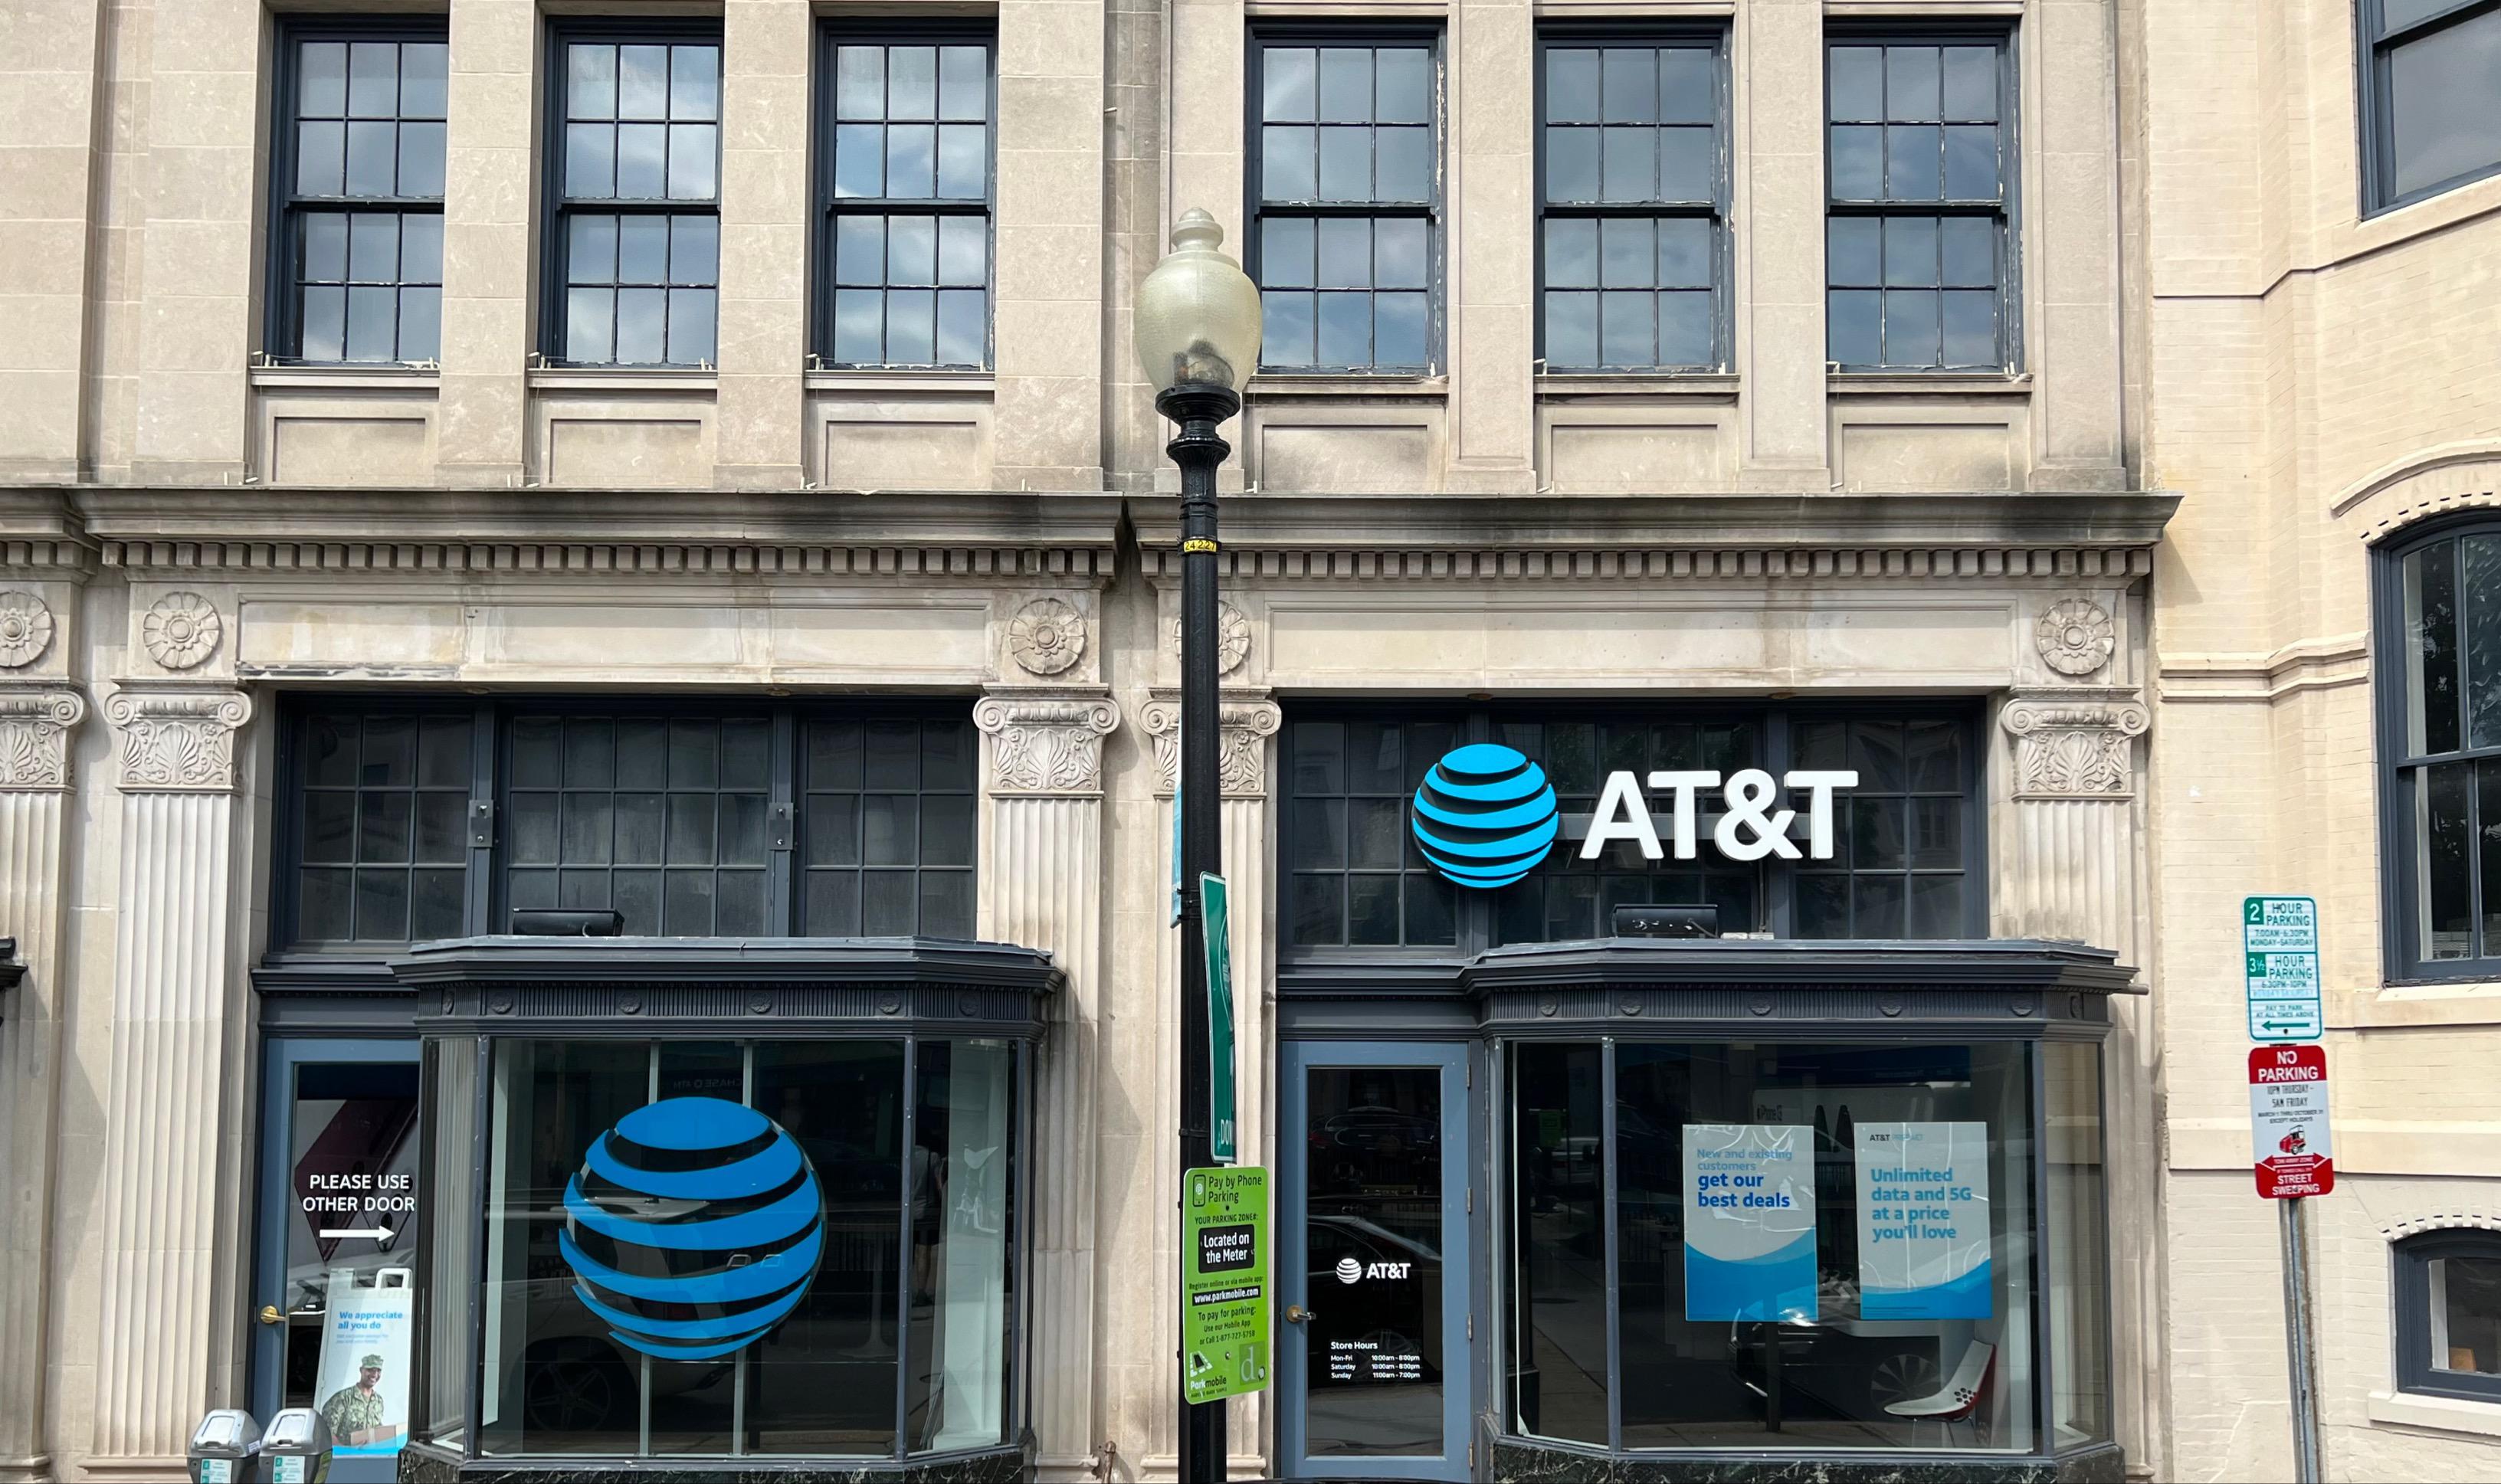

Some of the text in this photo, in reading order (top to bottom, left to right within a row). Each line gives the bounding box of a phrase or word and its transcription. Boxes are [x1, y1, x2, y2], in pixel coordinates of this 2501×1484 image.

[1578, 768, 1859, 862] AT&T
[2250, 903, 2260, 921] 2
[2272, 903, 2303, 913] HOUR
[2267, 916, 2310, 925] PARKING
[2275, 955, 2305, 967] HOUR
[2270, 968, 2313, 979] PARKING
[2276, 1050, 2298, 1064] NO
[2258, 1066, 2319, 1082] PARKING
[1697, 1148, 1792, 1161] New and existing
[1697, 1161, 1756, 1171] customers
[310, 1174, 410, 1190] PLEASE USE
[1208, 1174, 1262, 1190] Pay by Phone
[1698, 1173, 1764, 1191] get our
[1870, 1168, 1953, 1182] Unlimited
[2277, 1173, 2313, 1184] STREET
[1871, 1187, 1972, 1201] data and 5G
[2272, 1183, 2320, 1196] SWEEPING
[303, 1196, 415, 1212] OTHER DOOR
[1208, 1191, 1239, 1204] Parking
[1698, 1191, 1790, 1207] best deals
[1195, 1216, 1211, 1224] YOUR
[1212, 1214, 1237, 1224] PARKING
[1872, 1205, 1950, 1224] at a price
[1922, 1224, 1956, 1239] love
[1204, 1232, 1250, 1248] Located on
[1206, 1249, 1247, 1263] the Meter
[1366, 1263, 1411, 1279] AT&T
[1194, 1288, 1259, 1303] www.parkmobile.com
[355, 1311, 403, 1321] appreciate
[1198, 1312, 1206, 1322] To
[1207, 1312, 1219, 1322] pay
[1221, 1308, 1230, 1318] for
[338, 1321, 381, 1331] all you do
[1205, 1335, 1215, 1345] Call
[1330, 1341, 1353, 1350] Store
[1190, 1375, 1227, 1390] Parkmobile
